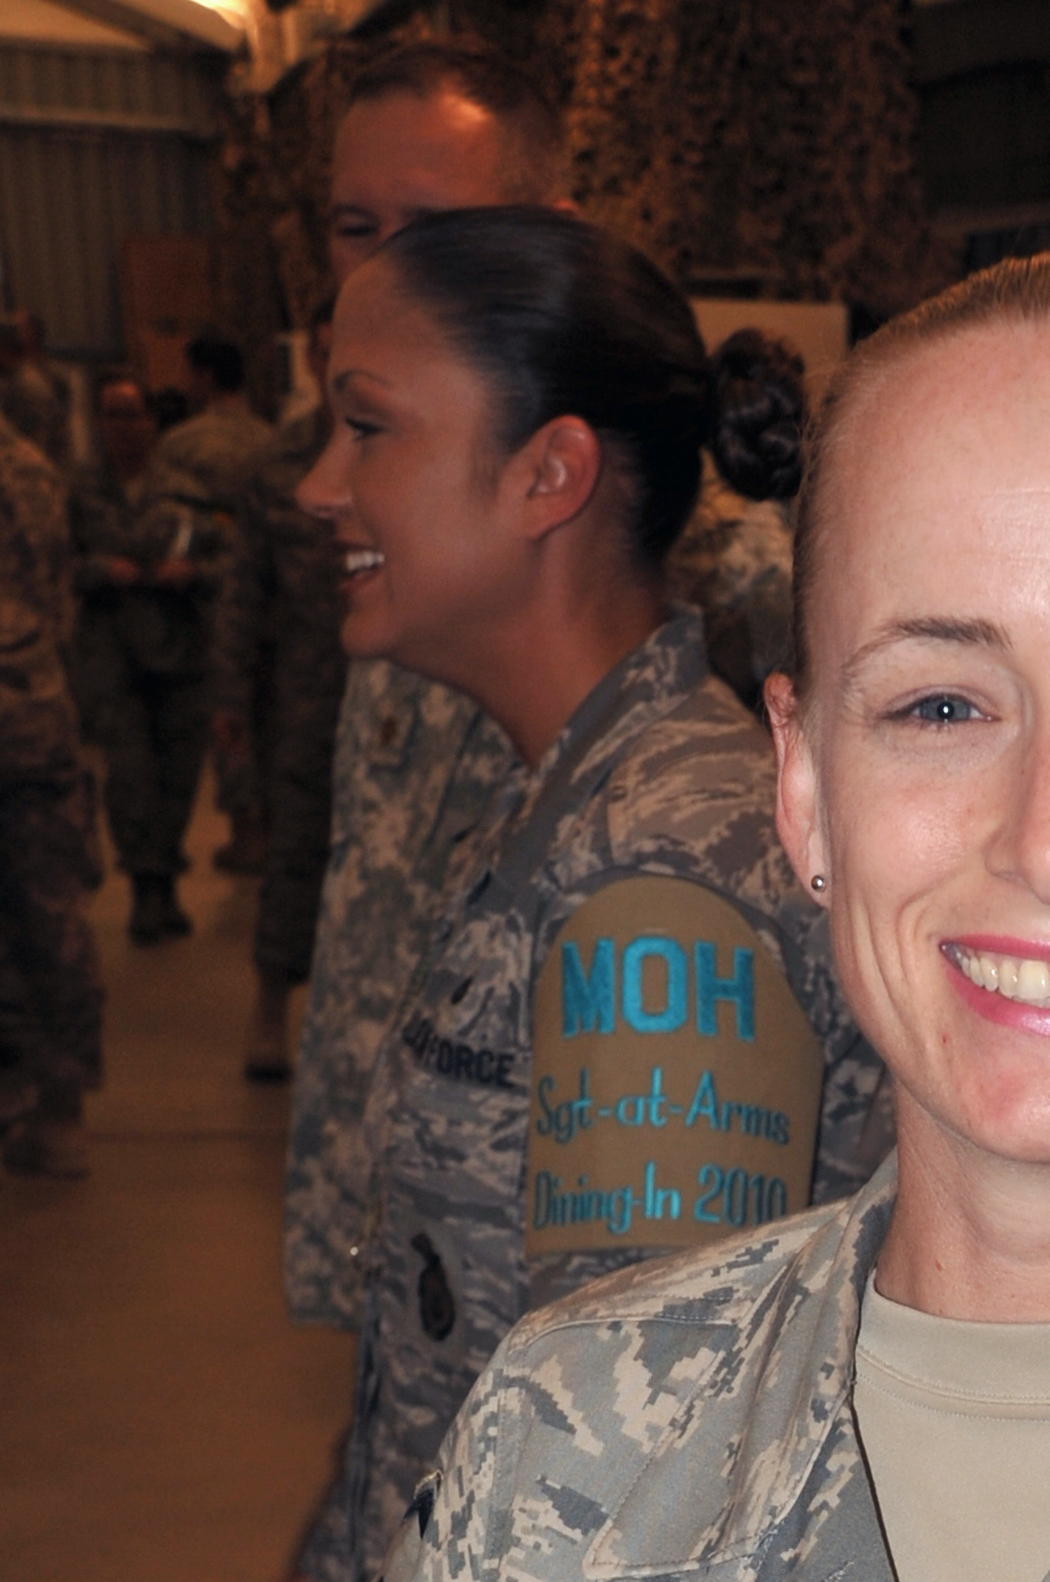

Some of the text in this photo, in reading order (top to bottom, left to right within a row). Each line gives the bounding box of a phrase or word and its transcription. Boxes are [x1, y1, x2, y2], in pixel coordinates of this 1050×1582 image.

[562, 936, 755, 1041] MOH
[536, 1066, 789, 1145] Sgt-at-Arms
[533, 1160, 787, 1235] Dining-In 2010
